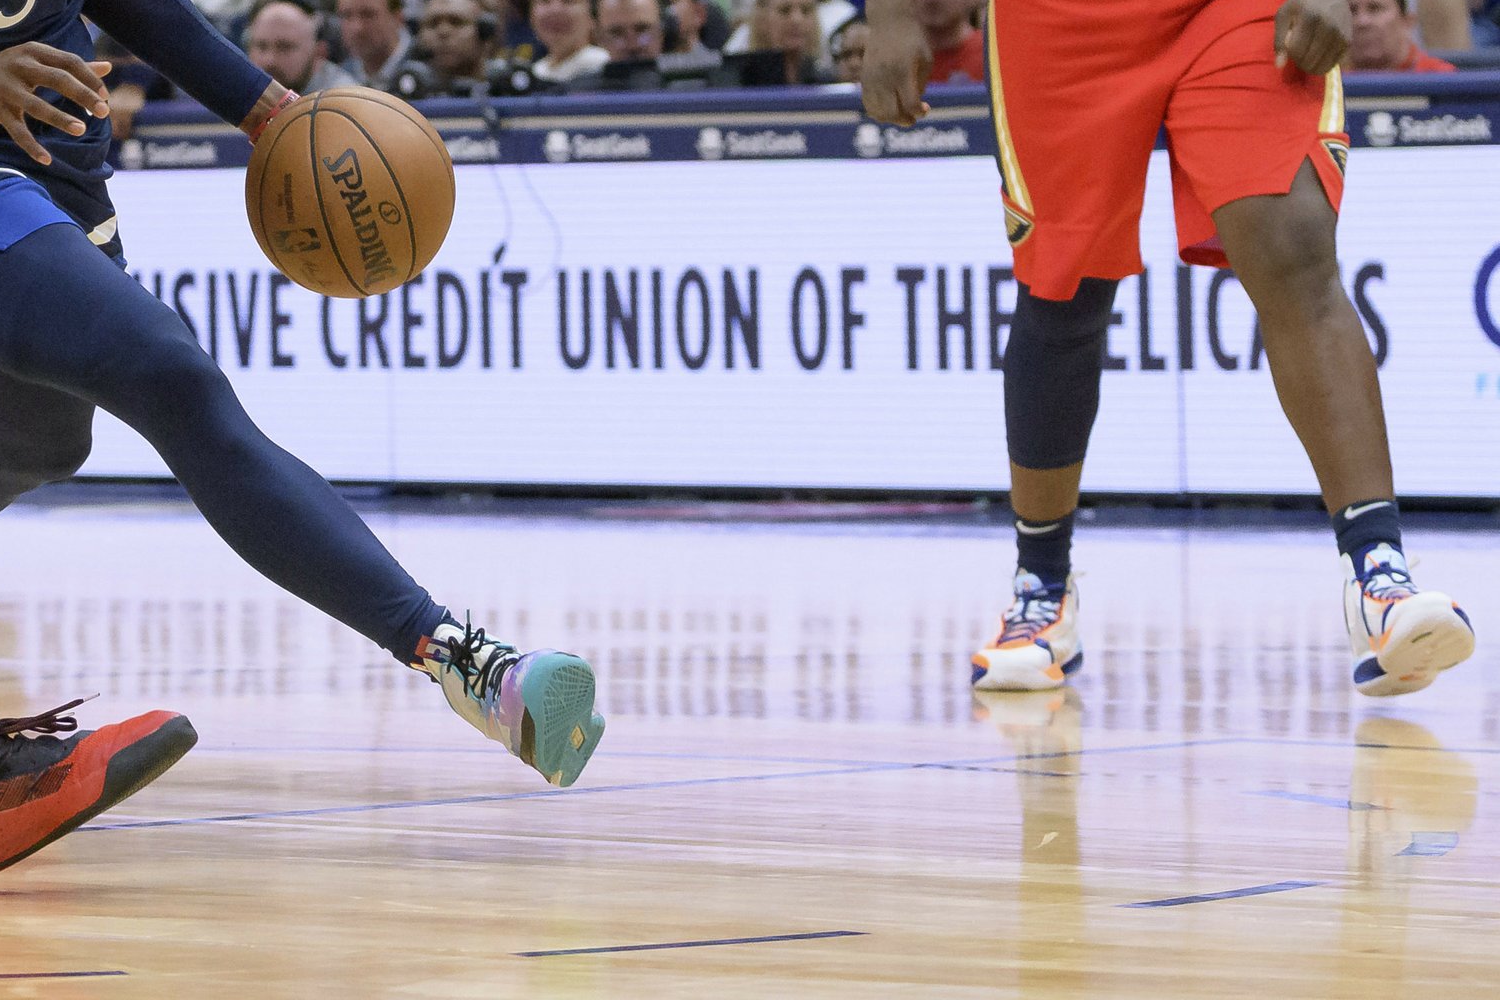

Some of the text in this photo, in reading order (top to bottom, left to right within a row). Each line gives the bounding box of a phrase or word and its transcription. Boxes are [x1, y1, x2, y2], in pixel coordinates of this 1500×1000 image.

[322, 148, 396, 288] SPALDING
[556, 267, 762, 371] UNION
[789, 267, 866, 371] OF
